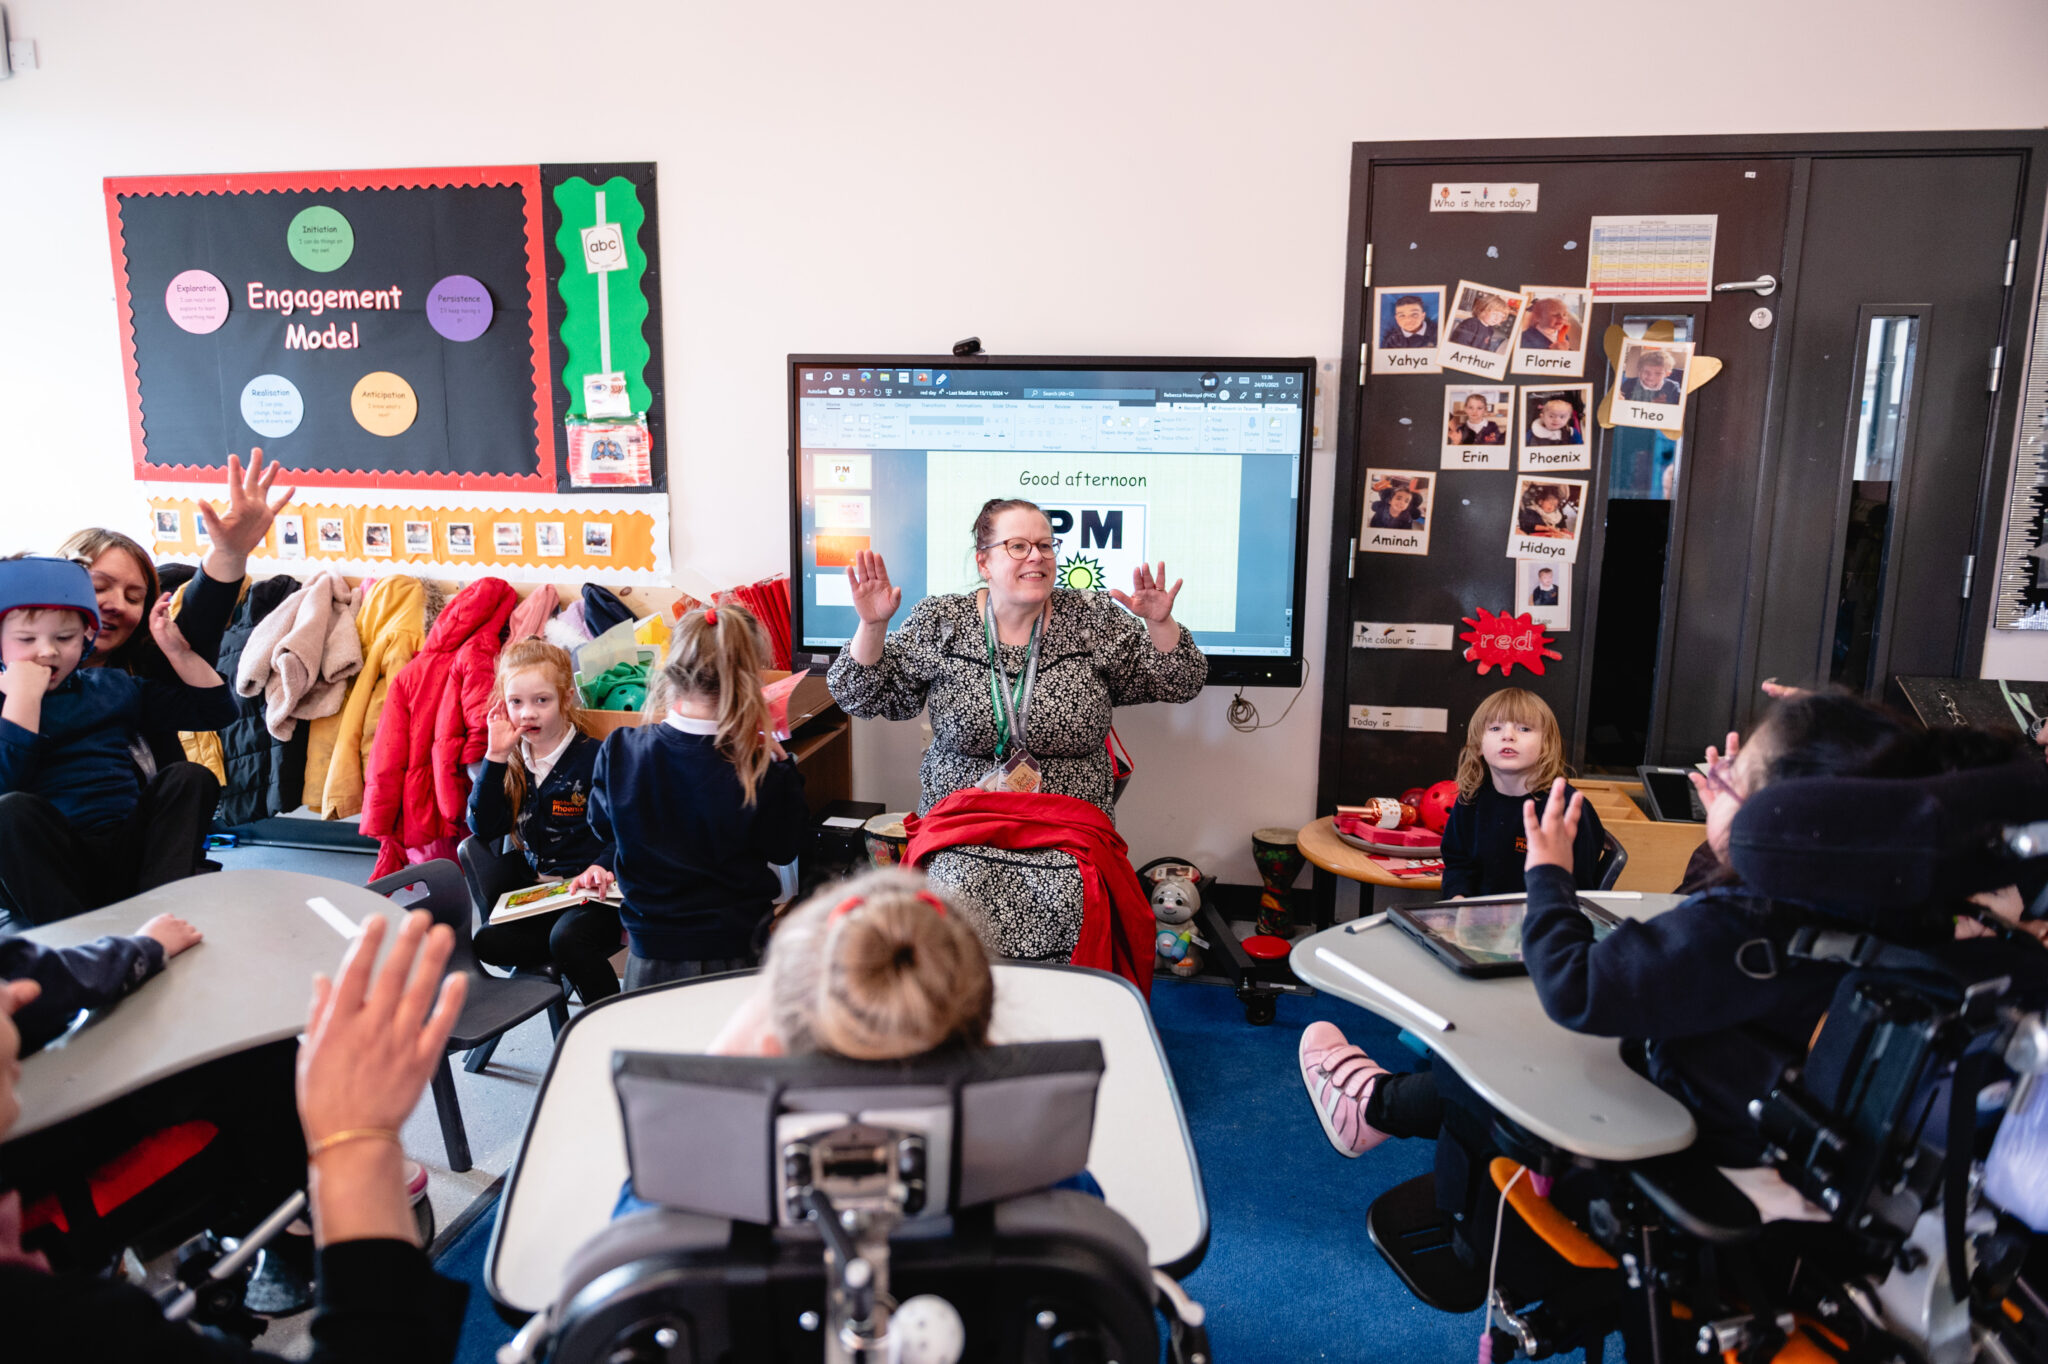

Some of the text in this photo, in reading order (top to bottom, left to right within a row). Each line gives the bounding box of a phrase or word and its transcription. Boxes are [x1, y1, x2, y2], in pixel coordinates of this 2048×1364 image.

[1434, 199, 1532, 209] Who is here today?
[302, 225, 338, 234] Initiation
[590, 239, 617, 253] abc
[176, 284, 217, 294] Exploration
[247, 282, 402, 316] Engagement
[437, 294, 481, 303] Persistence
[285, 321, 360, 351] Model
[1387, 354, 1428, 369] Yahya
[1450, 351, 1495, 370] Arthur
[1525, 354, 1572, 369] Florrie
[251, 389, 290, 397] Realisation
[362, 391, 406, 400] Anticipation
[1630, 406, 1664, 422] Theo
[1462, 450, 1489, 463] Erin
[1529, 451, 1581, 464] Phoenix
[1019, 470, 1147, 488] Good afternoon
[1371, 534, 1418, 548] Aminah
[1519, 541, 1566, 557] Hidaya
[1356, 634, 1415, 645] The colour is
[1480, 629, 1533, 651] red
[1351, 716, 1390, 728] Today is
